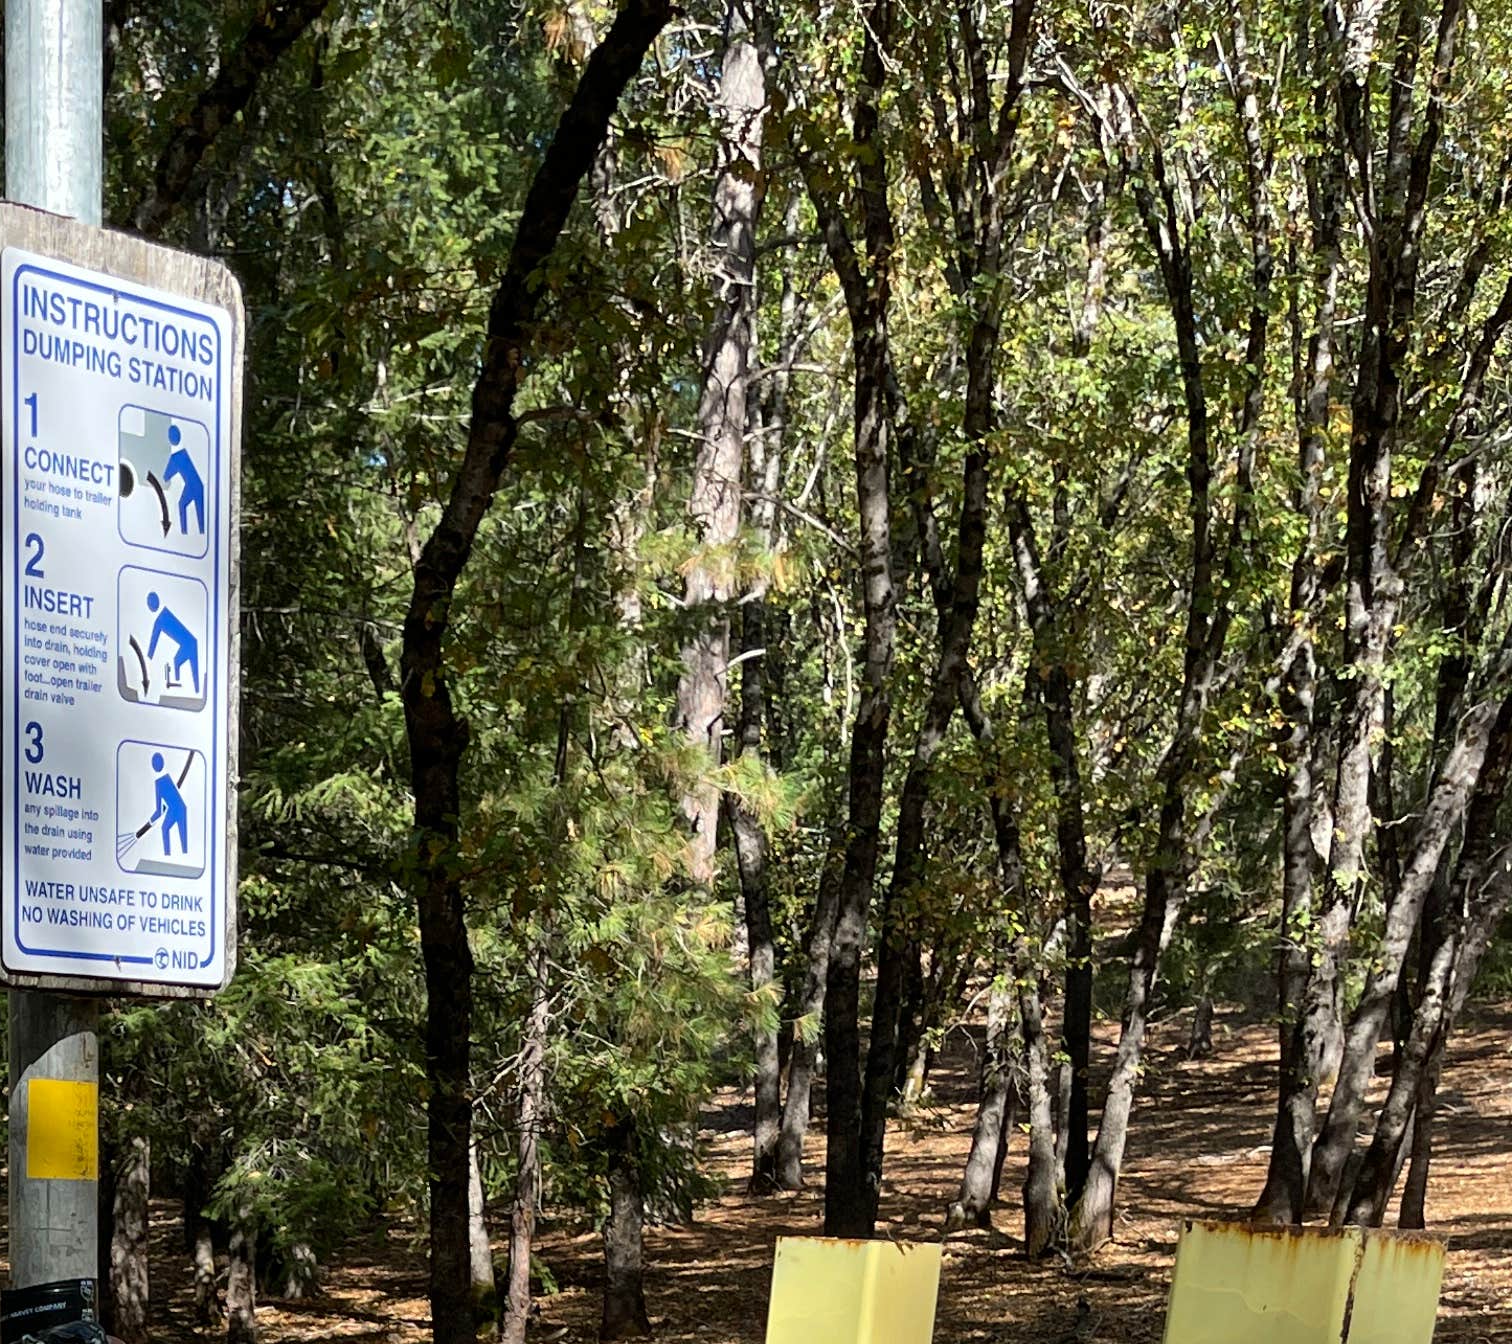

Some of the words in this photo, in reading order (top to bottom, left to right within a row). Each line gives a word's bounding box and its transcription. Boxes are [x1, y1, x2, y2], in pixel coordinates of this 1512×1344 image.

[23, 284, 213, 366] INSTRUCTIONS
[23, 328, 122, 378] DUMPING
[128, 356, 213, 402] STATION
[24, 393, 38, 437] 1
[24, 446, 114, 487] CONNECT
[24, 478, 47, 491] your
[48, 481, 71, 497] hose
[73, 488, 83, 500] to
[62, 505, 82, 519] tank
[24, 533, 45, 578] 2
[24, 584, 94, 619] INSERT
[24, 617, 47, 632] hose
[49, 624, 67, 636] end
[24, 635, 42, 649] into
[73, 643, 108, 663] holding
[24, 655, 50, 667] cover
[52, 659, 75, 673] open
[78, 662, 97, 675] with
[24, 688, 48, 702] drain
[24, 721, 45, 763] 3
[24, 771, 81, 800] WASH
[81, 808, 99, 822] into
[24, 822, 40, 835] the
[41, 824, 65, 838] drain
[67, 828, 93, 843] using
[24, 844, 50, 856] water
[52, 847, 92, 861] provided
[25, 880, 75, 901] WATER
[79, 886, 136, 907] UNSAFE
[139, 891, 157, 909] TO
[161, 893, 203, 912] DRINK
[22, 905, 43, 923] NO
[47, 909, 113, 930] WASHING
[117, 914, 136, 931] OF
[139, 916, 206, 937] VEHICLES
[172, 950, 198, 970] NID
